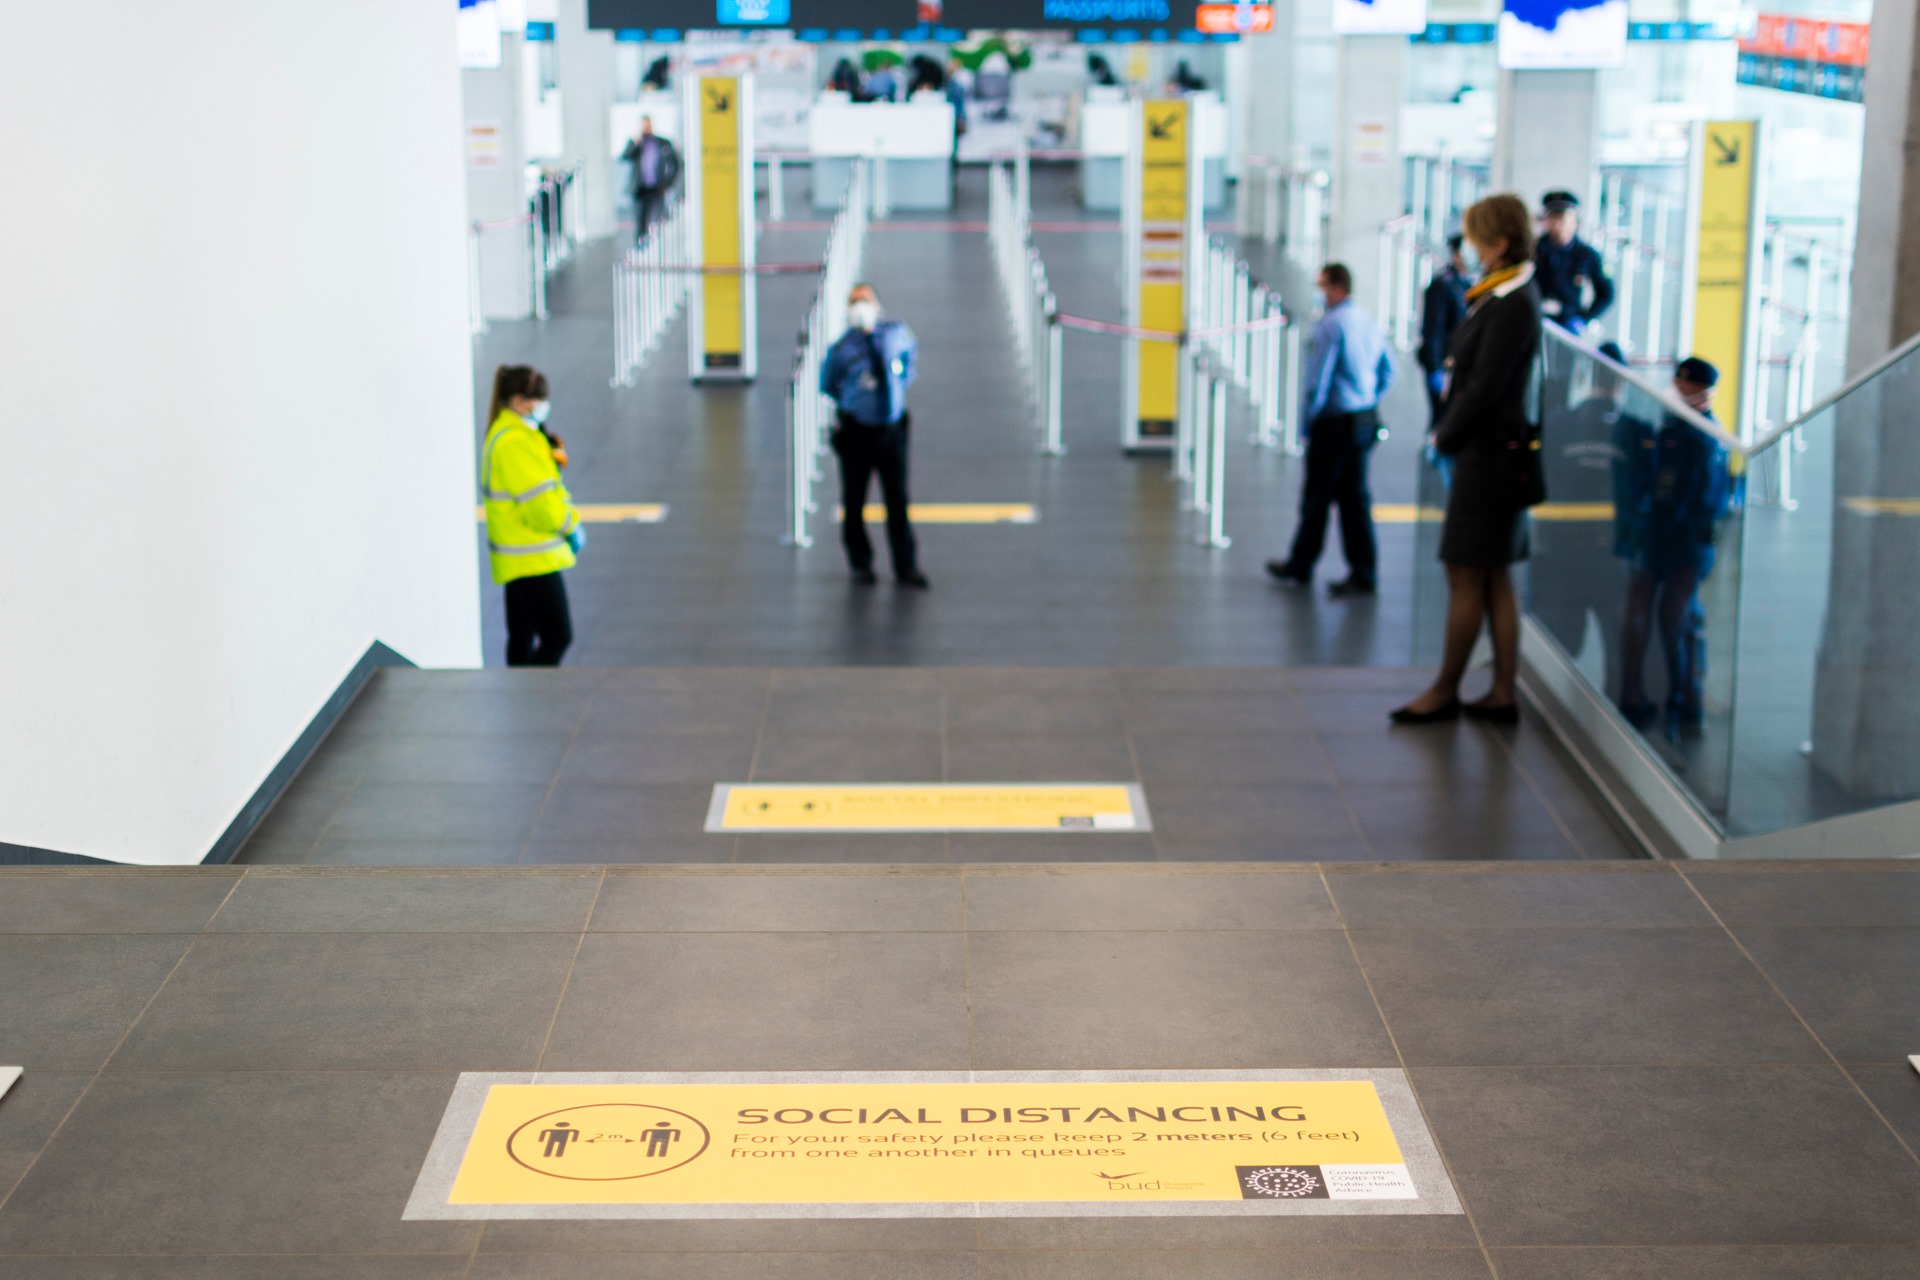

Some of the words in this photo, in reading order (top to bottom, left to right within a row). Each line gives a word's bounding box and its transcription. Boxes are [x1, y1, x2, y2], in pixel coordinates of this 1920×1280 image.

[737, 1107, 943, 1125] SOCIAL
[959, 1105, 1307, 1124] DISTANCING
[733, 1133, 778, 1144] For
[786, 1135, 849, 1146] your
[857, 1133, 944, 1145] safety
[953, 1132, 1045, 1145] please
[1053, 1132, 1123, 1144] keep
[1131, 1131, 1148, 1142] 2
[1156, 1132, 1253, 1142] meters
[1261, 1131, 1288, 1143] (6
[1296, 1130, 1360, 1143] feet)
[730, 1147, 796, 1158] from
[805, 1149, 859, 1158] one
[867, 1147, 978, 1158] another
[987, 1146, 1012, 1157] in
[1021, 1148, 1126, 1159] queues
[1108, 1179, 1161, 1190] bud
